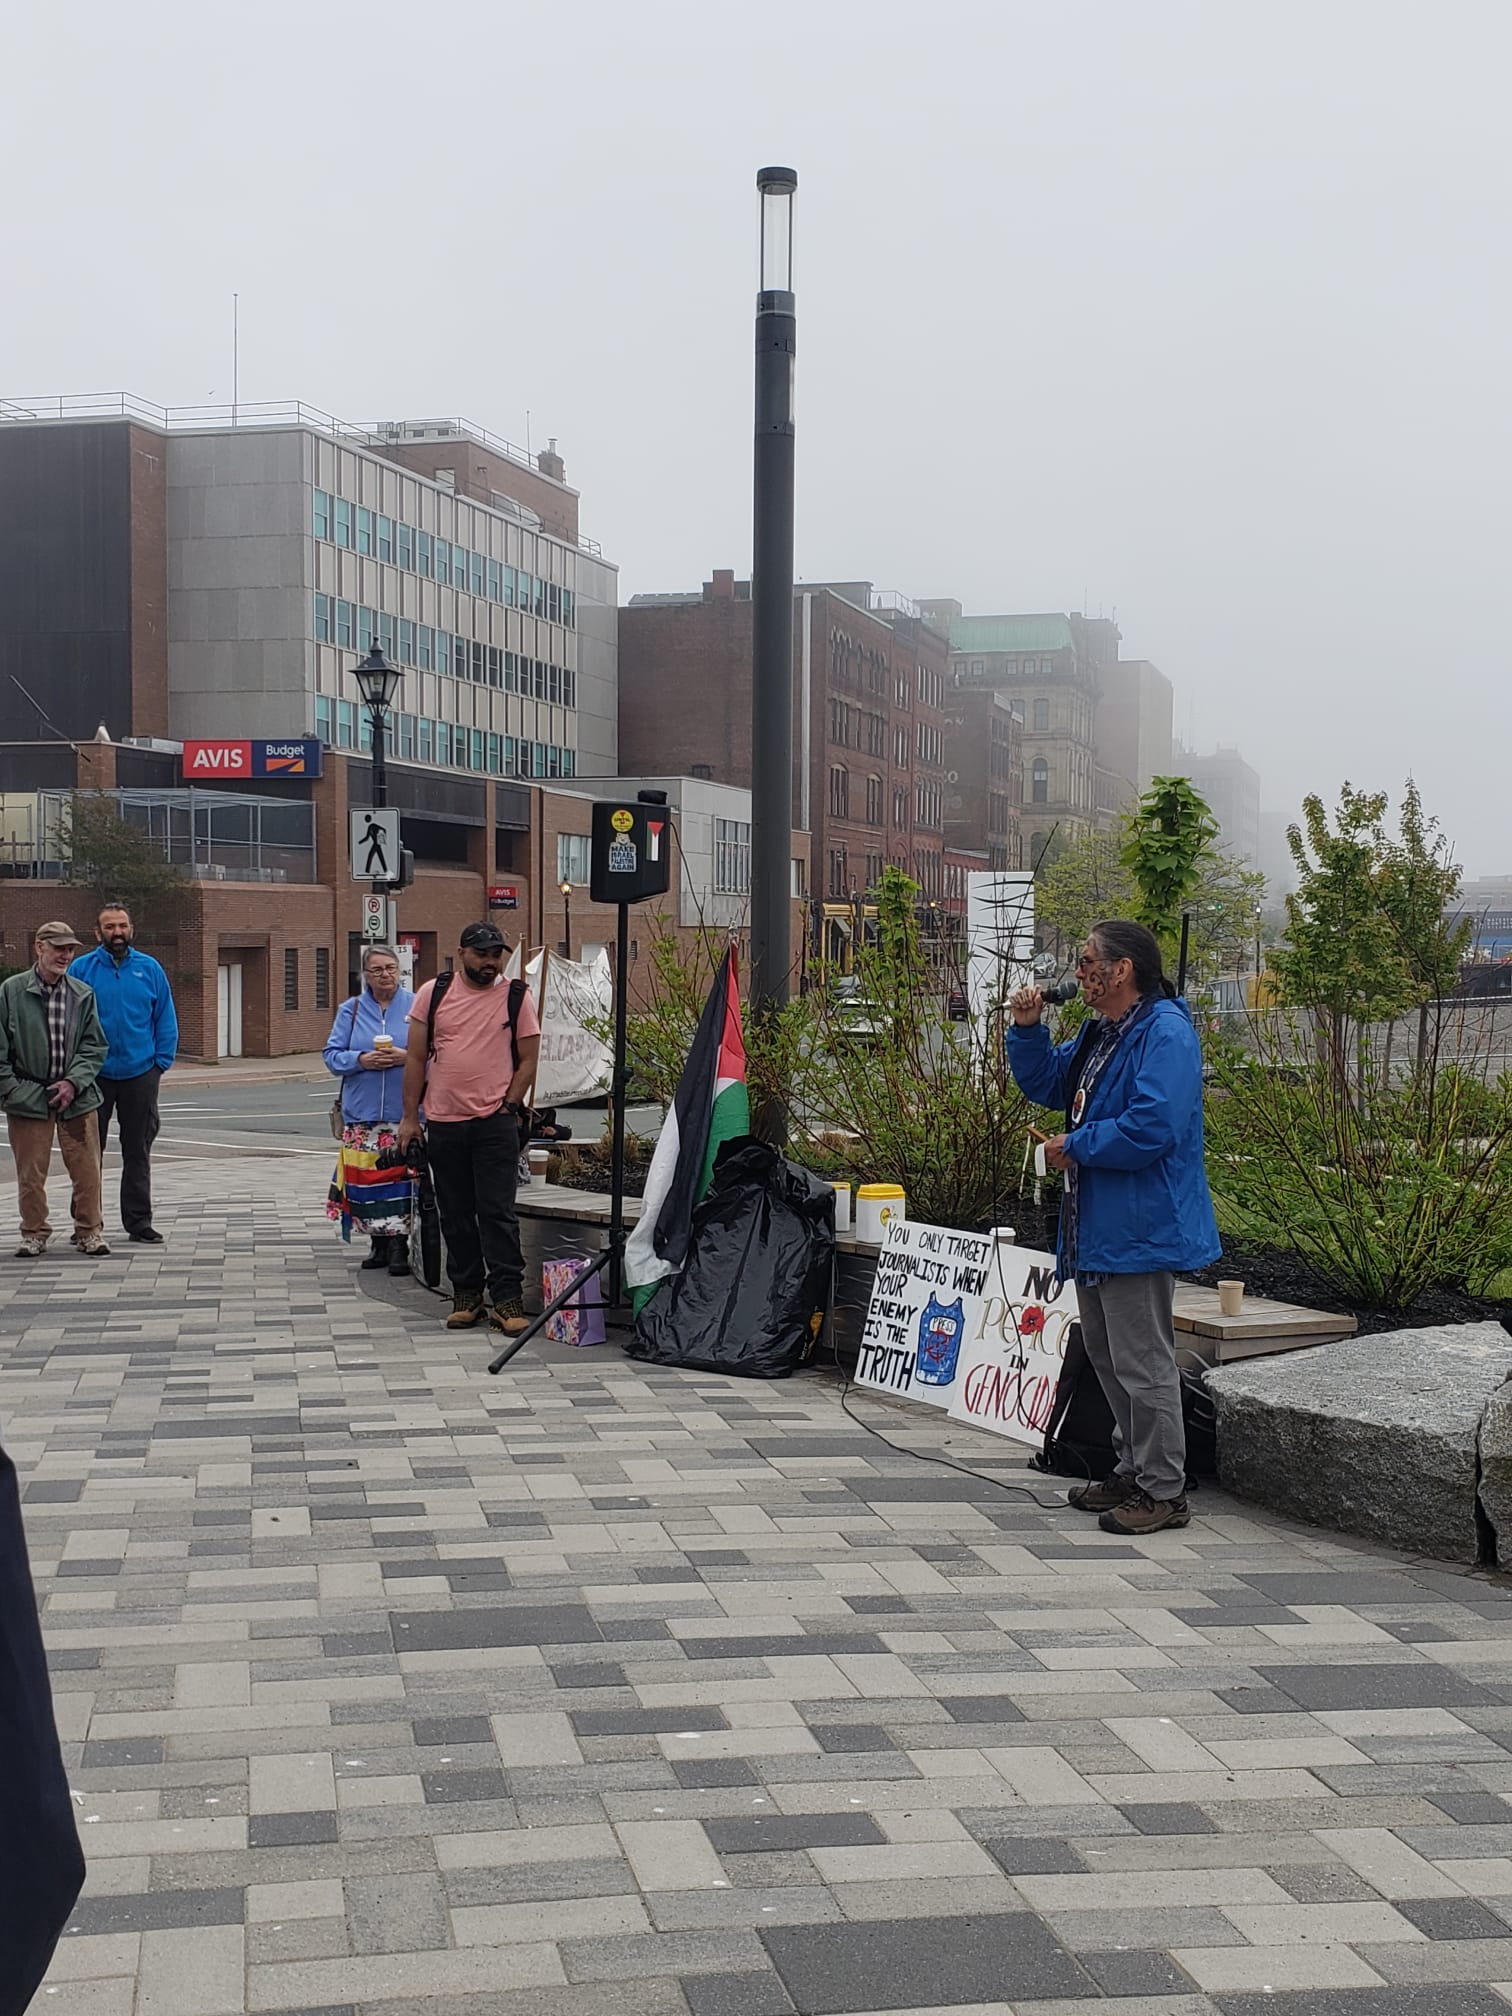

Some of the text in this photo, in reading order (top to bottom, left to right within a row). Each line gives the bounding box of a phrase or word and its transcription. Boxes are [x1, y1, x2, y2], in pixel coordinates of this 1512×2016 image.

[193, 749, 243, 768] AVIS
[266, 745, 305, 758] Budget
[888, 1221, 991, 1265] YOU ONLY TARGET
[876, 1272, 908, 1299] YOUR
[879, 1250, 988, 1297] JOURNALISTS WHEN
[1022, 1264, 1064, 1305] NO
[870, 1298, 918, 1325] ENEMY
[933, 1317, 954, 1332] PRESS
[864, 1319, 910, 1345] IS THE
[859, 1343, 917, 1391] TRUTH
[1008, 1354, 1030, 1372] IN
